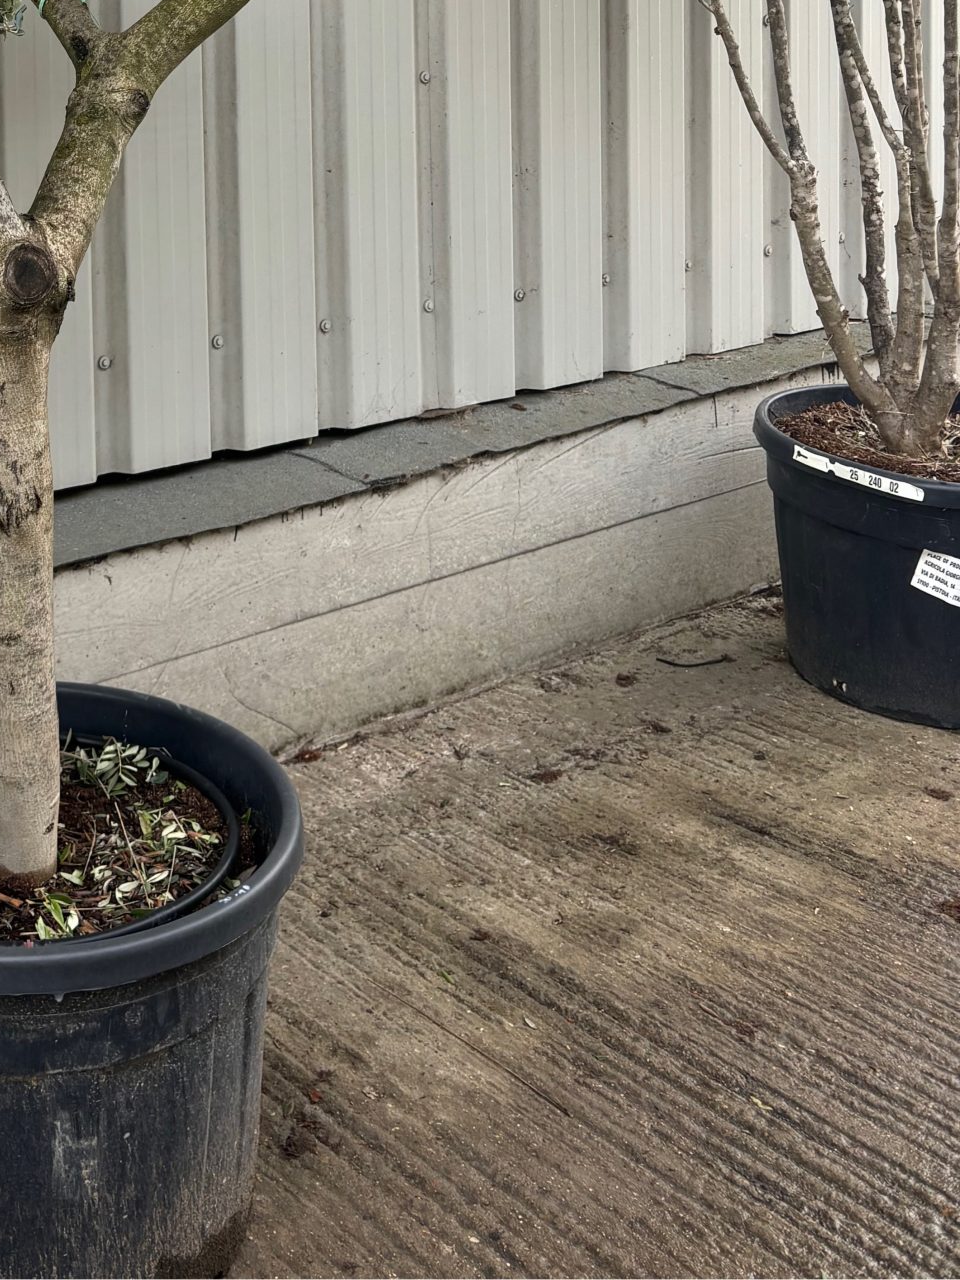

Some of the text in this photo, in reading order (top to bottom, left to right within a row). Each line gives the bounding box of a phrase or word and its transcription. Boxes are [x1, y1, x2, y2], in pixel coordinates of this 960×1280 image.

[849, 469, 900, 494] 25 240 02
